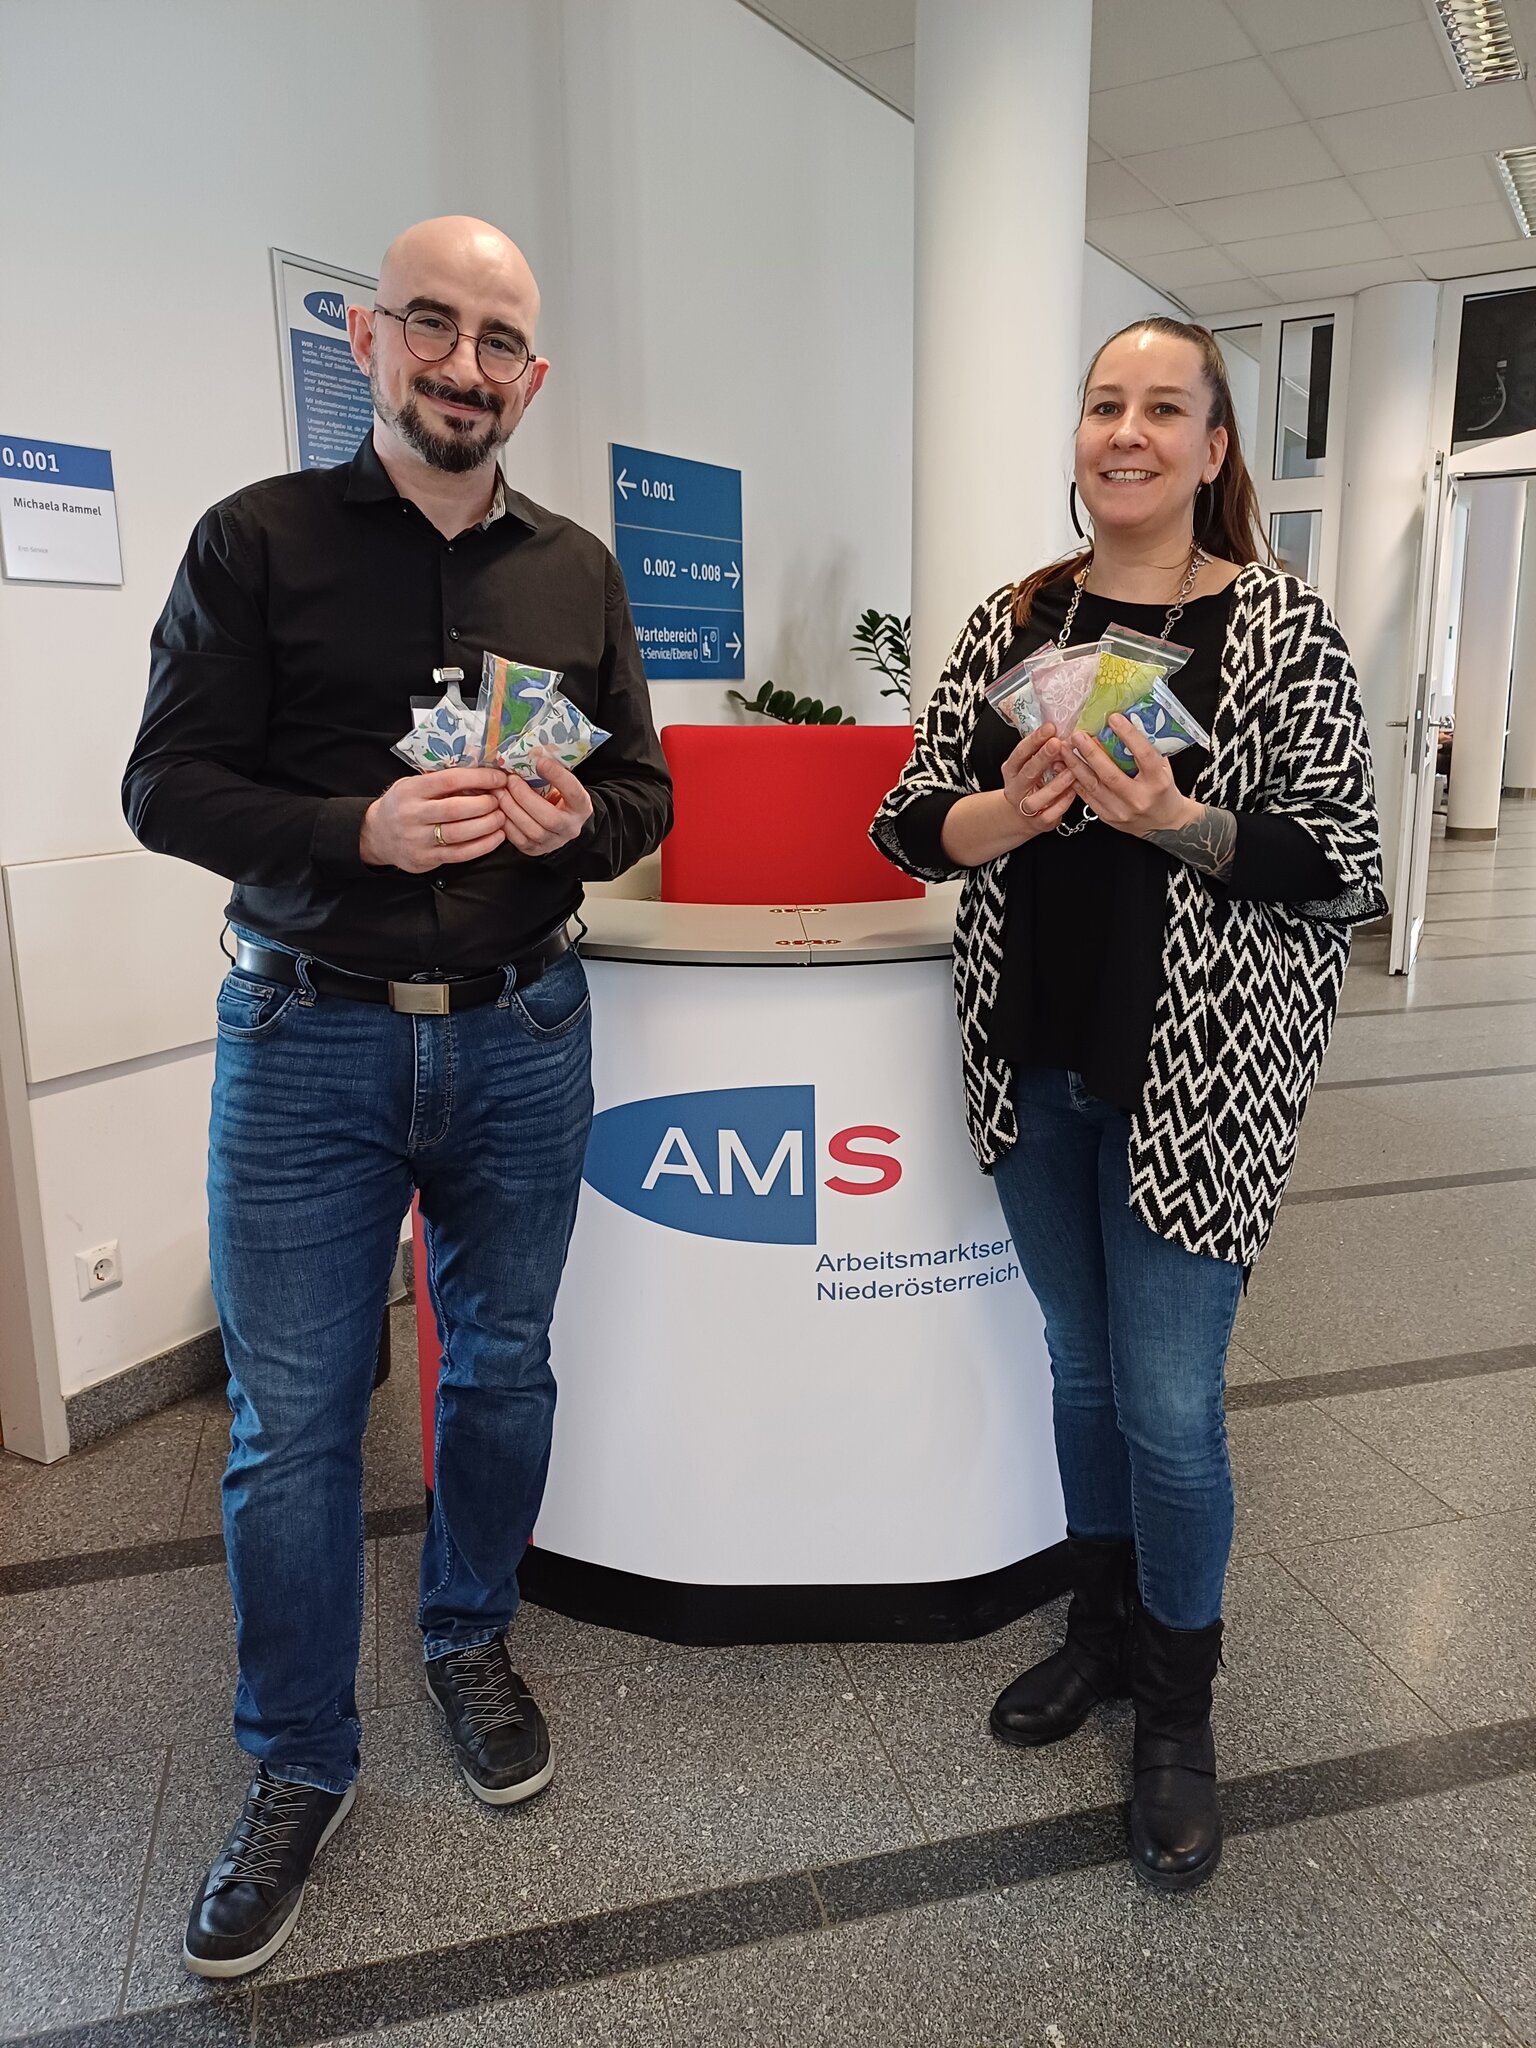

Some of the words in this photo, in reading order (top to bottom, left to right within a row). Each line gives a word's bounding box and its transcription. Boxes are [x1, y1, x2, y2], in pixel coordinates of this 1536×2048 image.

[318, 298, 345, 320] AM
[2, 447, 60, 473] 0.001
[641, 478, 676, 502] 0.001
[13, 497, 60, 512] Michaela
[62, 502, 102, 516] Rammel
[643, 557, 677, 578] 0.002
[690, 562, 721, 582] 0.008
[634, 625, 698, 643] Wartebereich
[640, 647, 693, 661] t-Service/Ebene
[641, 1125, 903, 1196] AMS
[815, 1238, 1013, 1272] Arbeitsmarktser
[816, 1262, 1020, 1301] Niederösterreich
